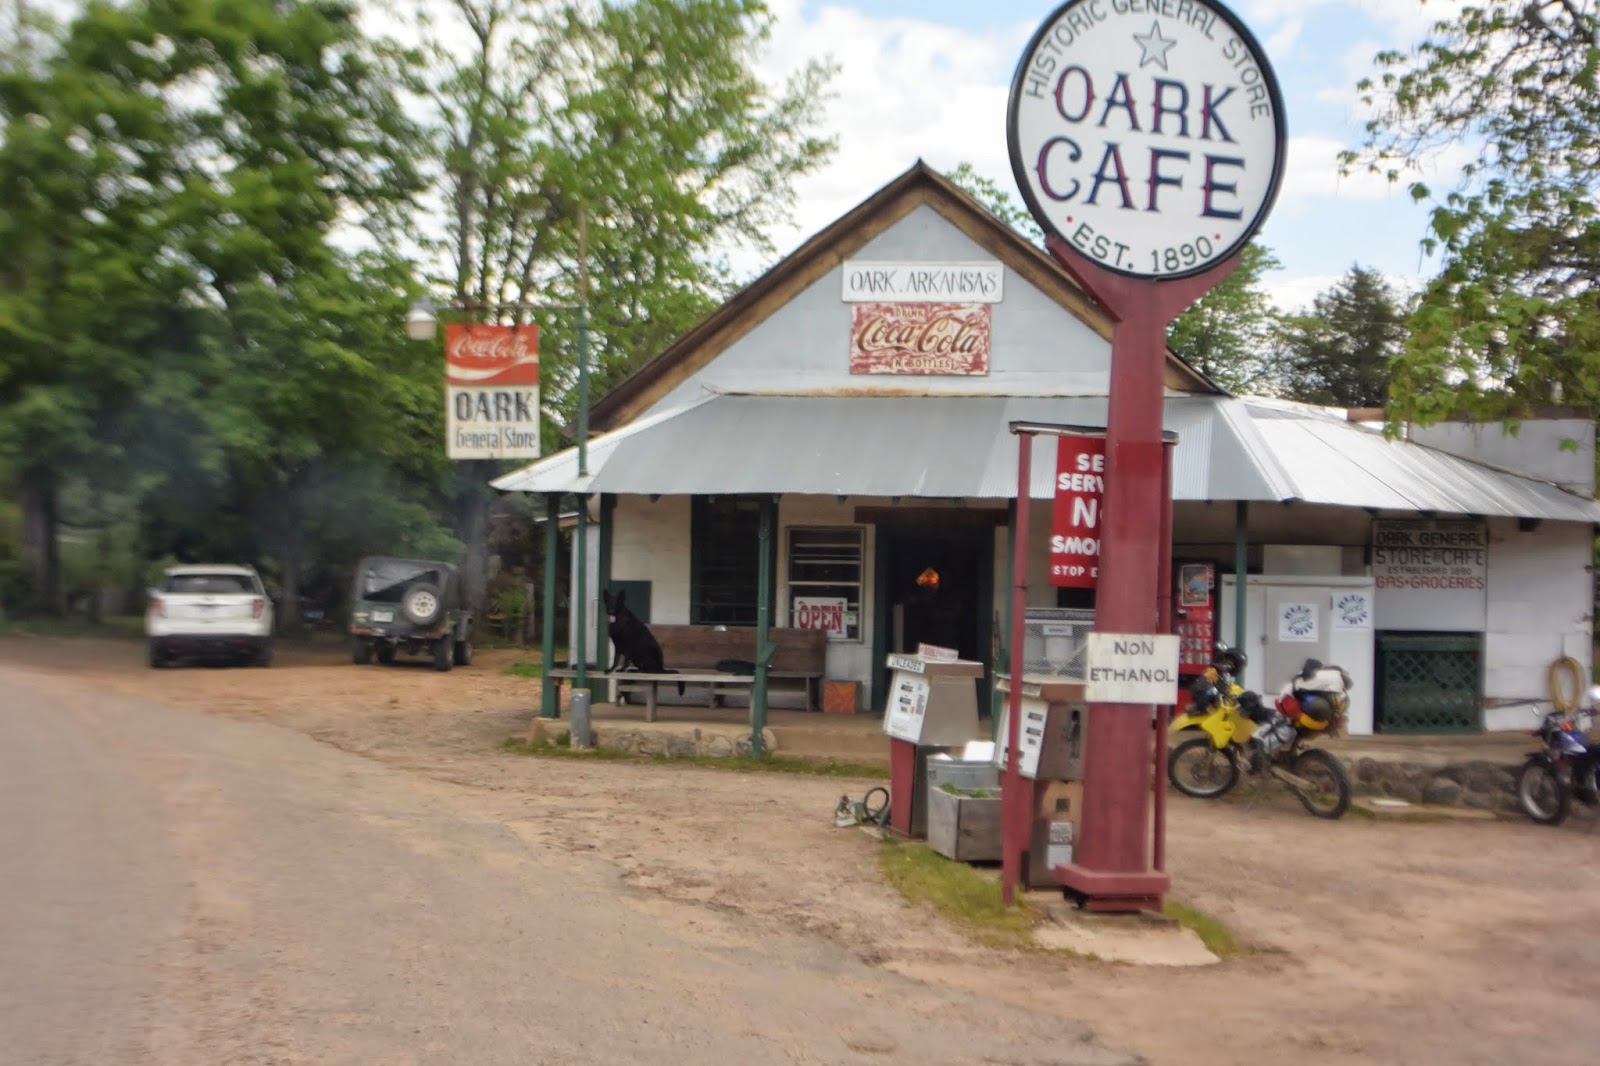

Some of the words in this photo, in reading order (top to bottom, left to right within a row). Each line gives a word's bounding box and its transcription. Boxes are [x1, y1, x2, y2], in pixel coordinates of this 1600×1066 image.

[1026, 2, 1107, 99] HISTORIC
[1113, 0, 1215, 41] GENERAL
[1222, 37, 1270, 121] STORE
[1054, 65, 1239, 144] OARK
[1035, 135, 1245, 221] CAFE
[1072, 222, 1134, 270] EST.
[1151, 236, 1213, 272] 1890
[903, 269, 997, 296] ARKANSAS
[455, 391, 534, 422] OARK
[505, 427, 536, 449] Store
[1072, 496, 1102, 529] N
[1419, 531, 1485, 547] GENERAL
[1375, 548, 1432, 565] STORE
[1442, 548, 1484, 565] CAFE
[1053, 565, 1086, 577] STOP
[1410, 575, 1485, 590] GROCERIES
[798, 603, 843, 632] OPEN
[1114, 640, 1155, 656] NON
[891, 655, 922, 672] UNLEADED
[1090, 668, 1175, 683] ETHANOL
